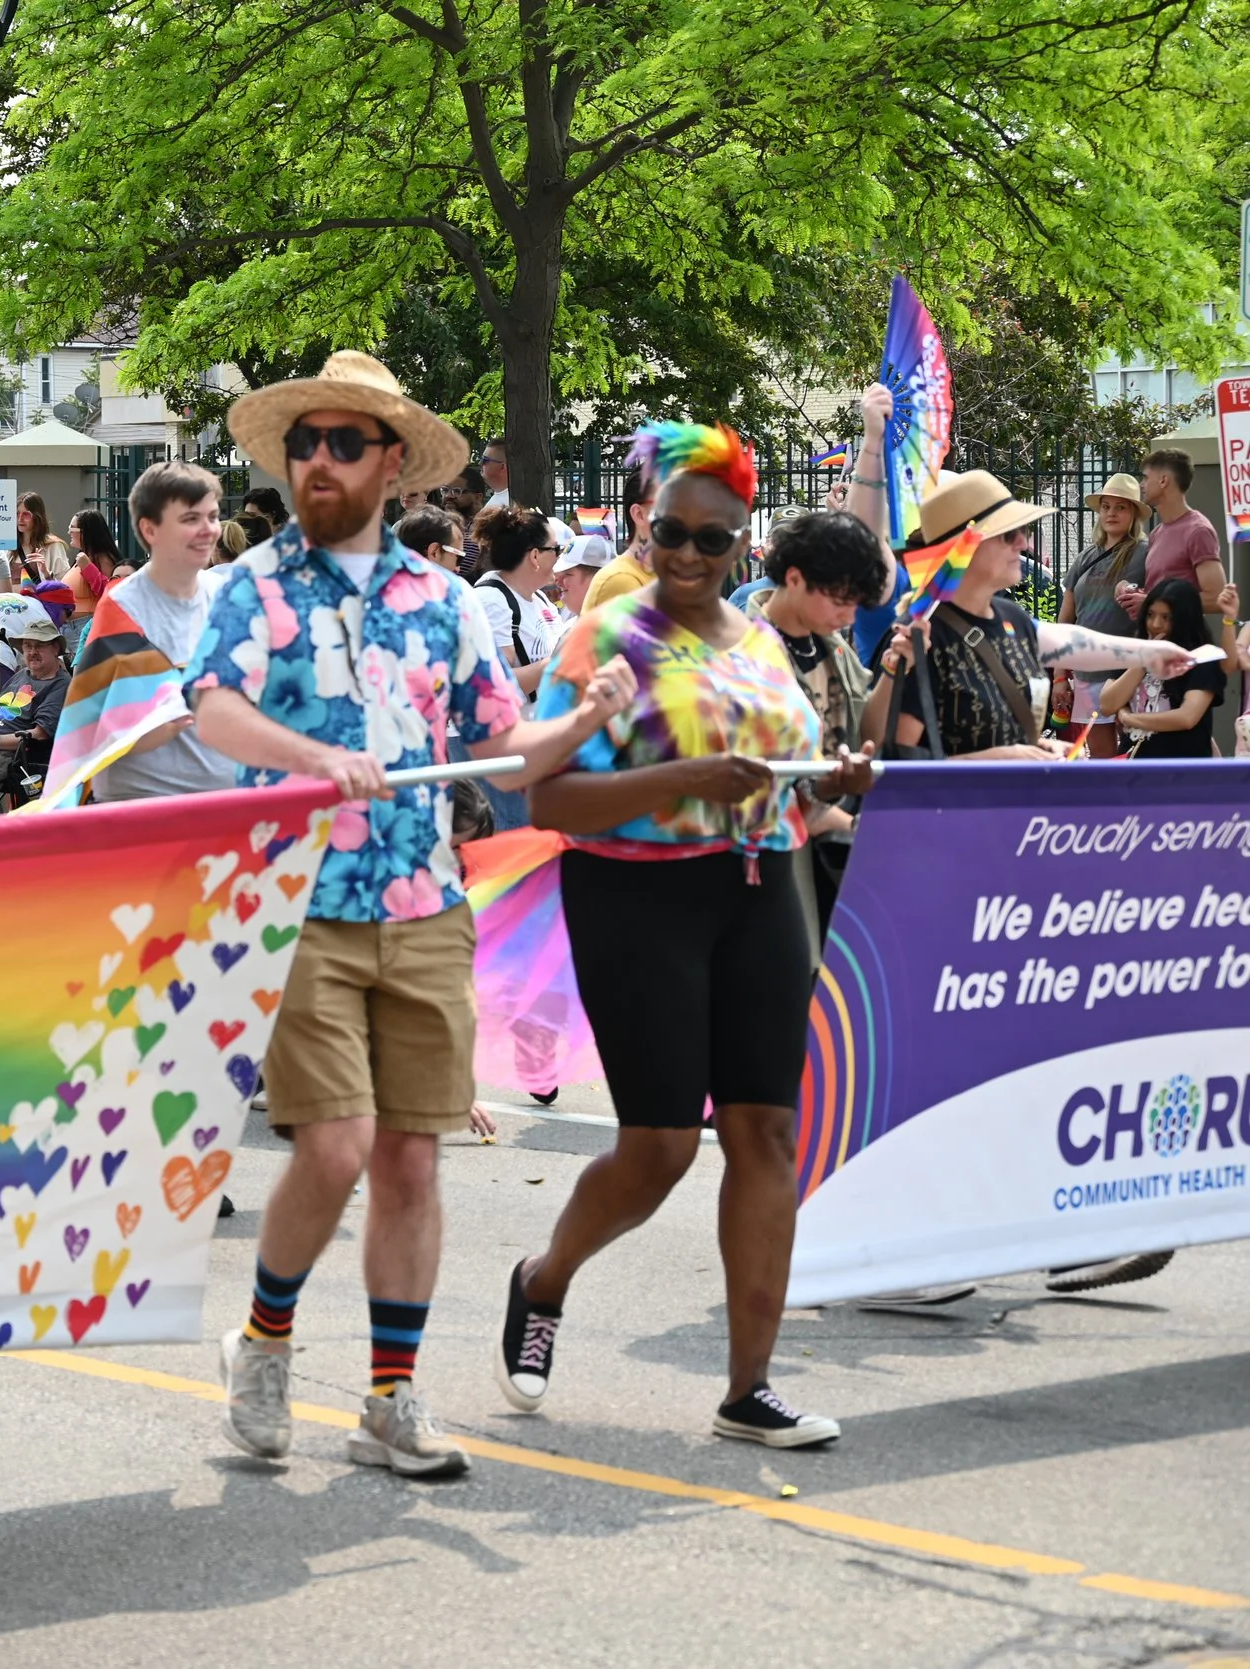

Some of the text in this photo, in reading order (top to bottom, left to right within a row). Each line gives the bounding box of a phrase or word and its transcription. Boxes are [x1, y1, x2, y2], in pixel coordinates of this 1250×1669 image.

[1016, 815, 1154, 861] Proudly
[972, 895, 1033, 943] We
[1039, 889, 1186, 938] believe
[933, 945, 1250, 1013] has the power to
[1053, 1164, 1247, 1211] COMMUNITY HEALTH
